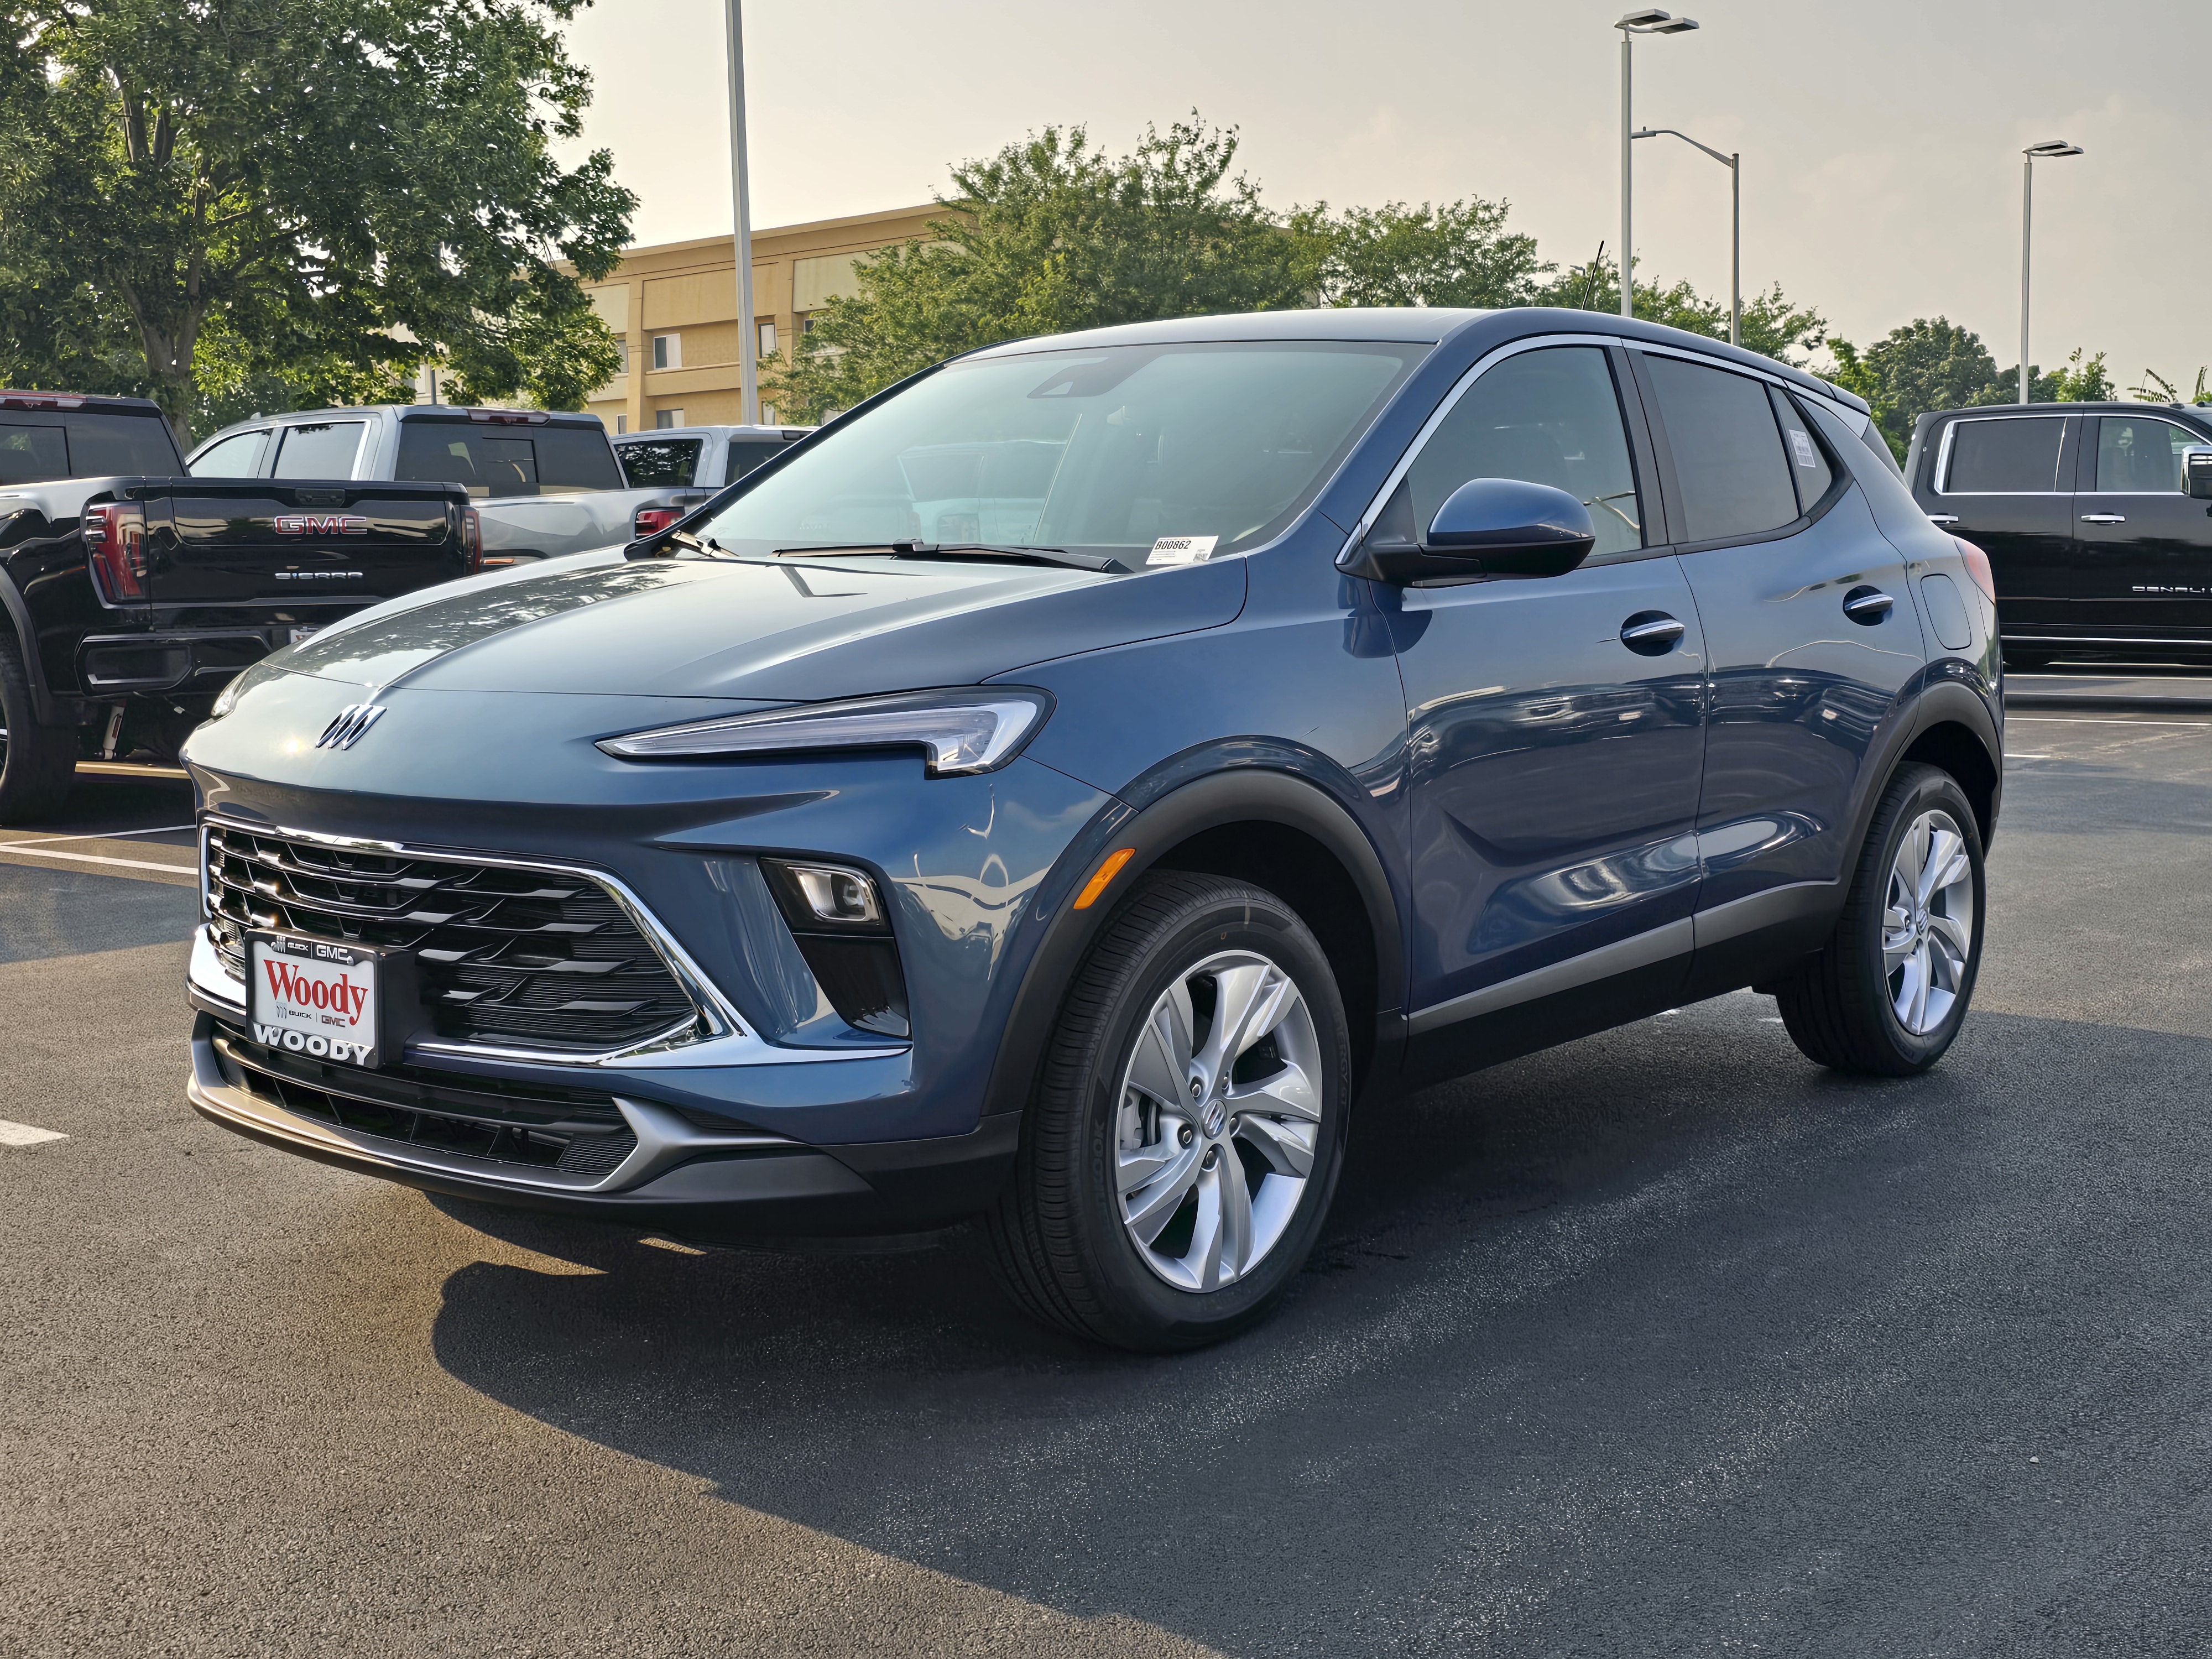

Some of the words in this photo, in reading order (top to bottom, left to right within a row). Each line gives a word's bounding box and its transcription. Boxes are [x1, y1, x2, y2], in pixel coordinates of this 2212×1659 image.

[274, 515, 368, 535] GMC
[287, 942, 309, 951] BUICK
[316, 945, 348, 960] GMC
[263, 959, 368, 1026] Woody
[289, 1010, 312, 1019] BUICK
[321, 1015, 346, 1028] GMC
[253, 1024, 374, 1066] WOODY
